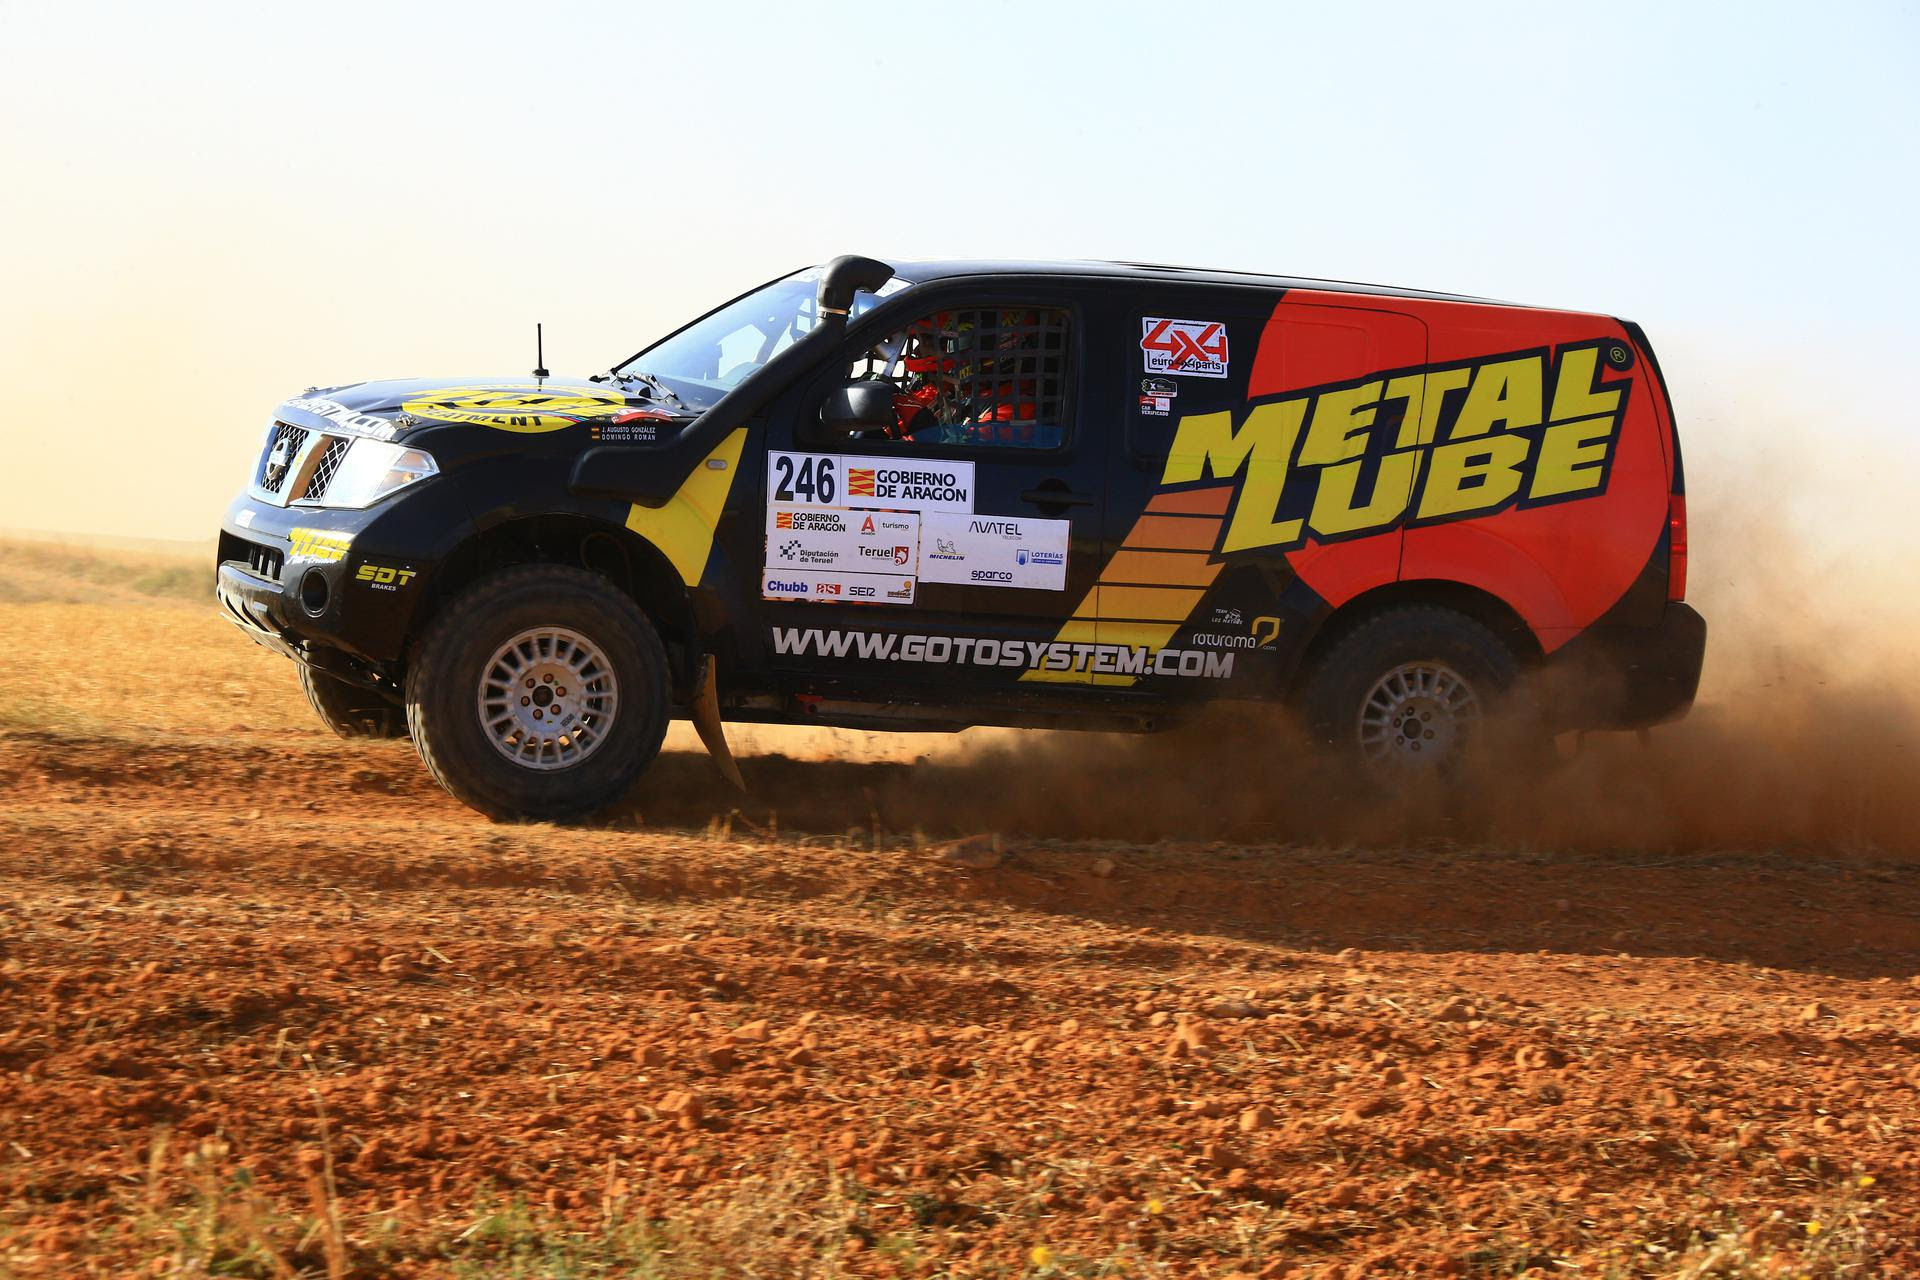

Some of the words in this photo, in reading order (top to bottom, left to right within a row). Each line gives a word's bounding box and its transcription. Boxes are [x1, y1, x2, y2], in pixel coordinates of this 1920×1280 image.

[1161, 347, 1622, 485] METAL
[601, 433, 631, 441] DOMINGO
[774, 455, 836, 504] 246
[876, 469, 956, 487] GOBIERNO
[1221, 415, 1616, 554] LUBE
[876, 484, 897, 499] DE
[901, 486, 967, 503] ARAGON
[793, 512, 840, 523] GOBIERNO
[792, 522, 805, 530] DE
[807, 522, 846, 532] ARAGON
[882, 522, 910, 530] turismo
[968, 521, 1022, 536] AVATEL
[799, 549, 839, 558] Diputación
[858, 545, 894, 558] Teruel
[356, 565, 416, 586] SDT
[971, 570, 1013, 580] sparco
[371, 583, 397, 592] BRAKES
[767, 580, 808, 593] Chubb
[1192, 633, 1256, 649] roturama
[772, 627, 1234, 679] WWW.GOTOSYSTEM.COM
